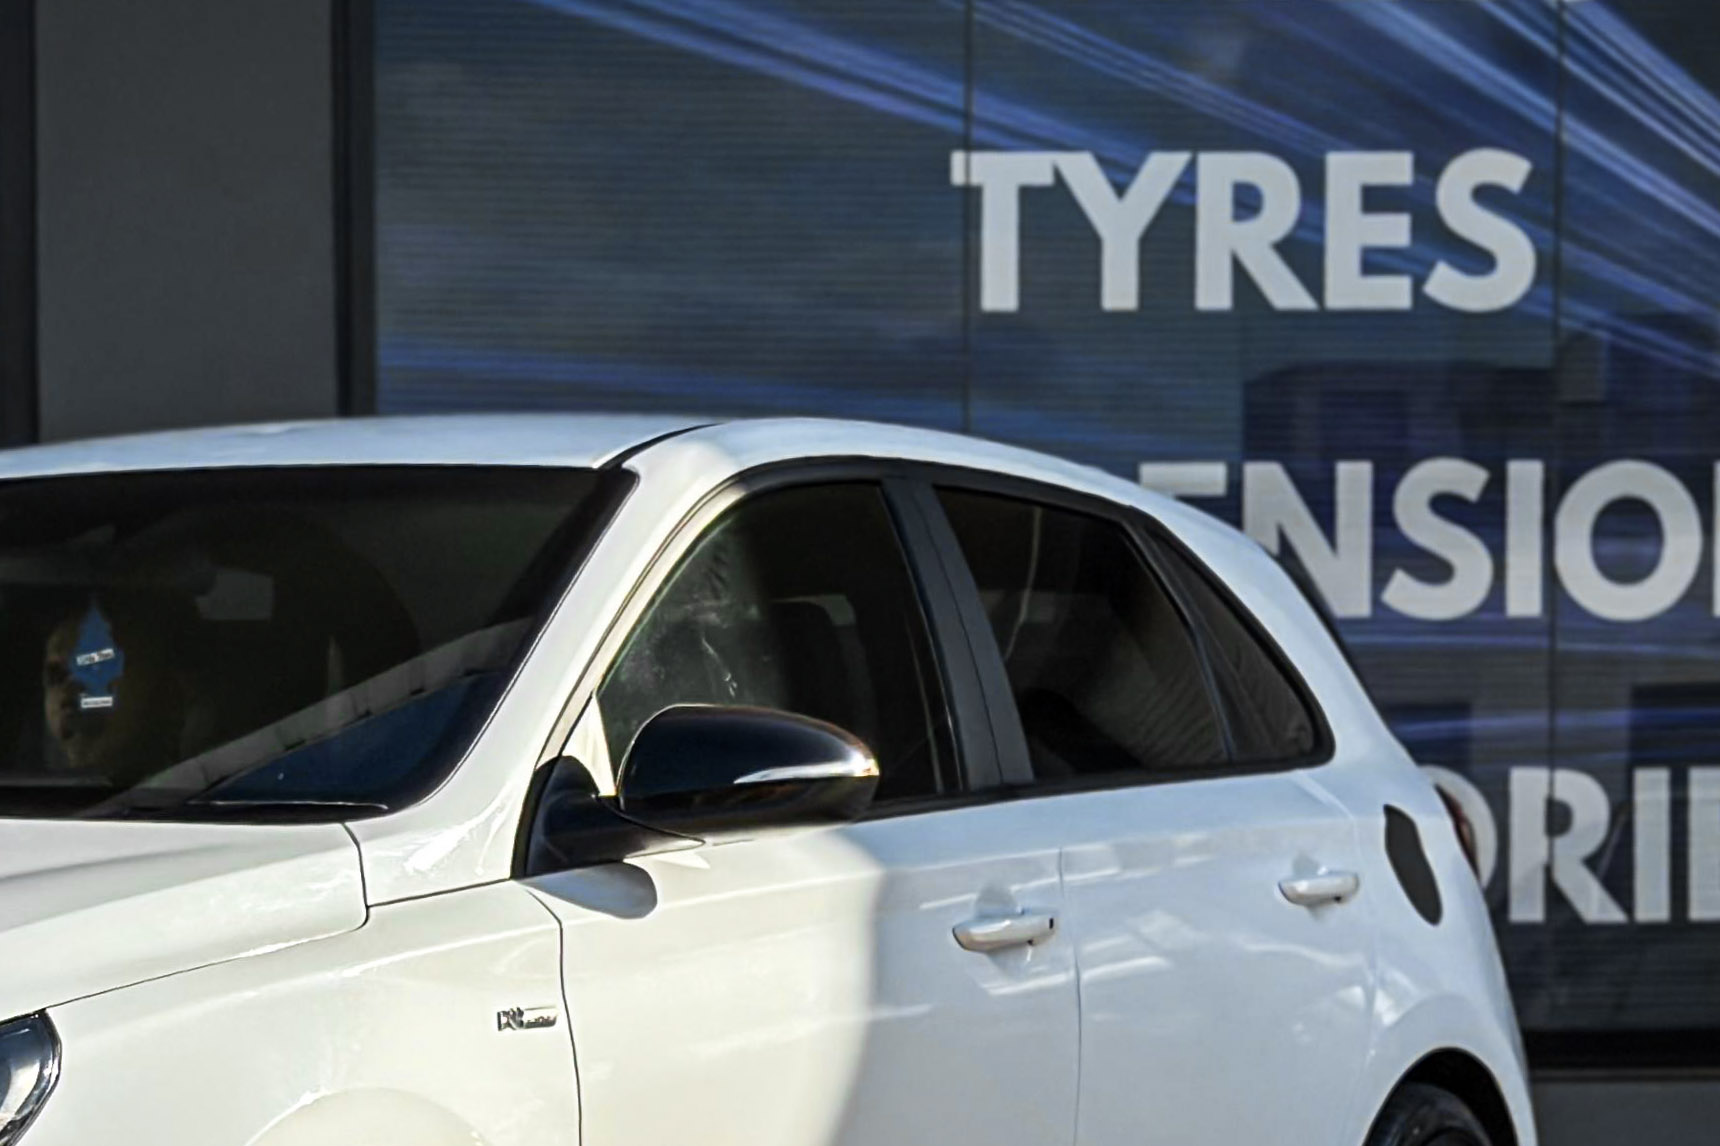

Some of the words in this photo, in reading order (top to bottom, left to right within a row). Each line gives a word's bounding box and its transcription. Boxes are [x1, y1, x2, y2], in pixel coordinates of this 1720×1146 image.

[951, 148, 1536, 311] TYRES
[1140, 457, 1720, 622] NSIO
[1417, 765, 1720, 924] RI
